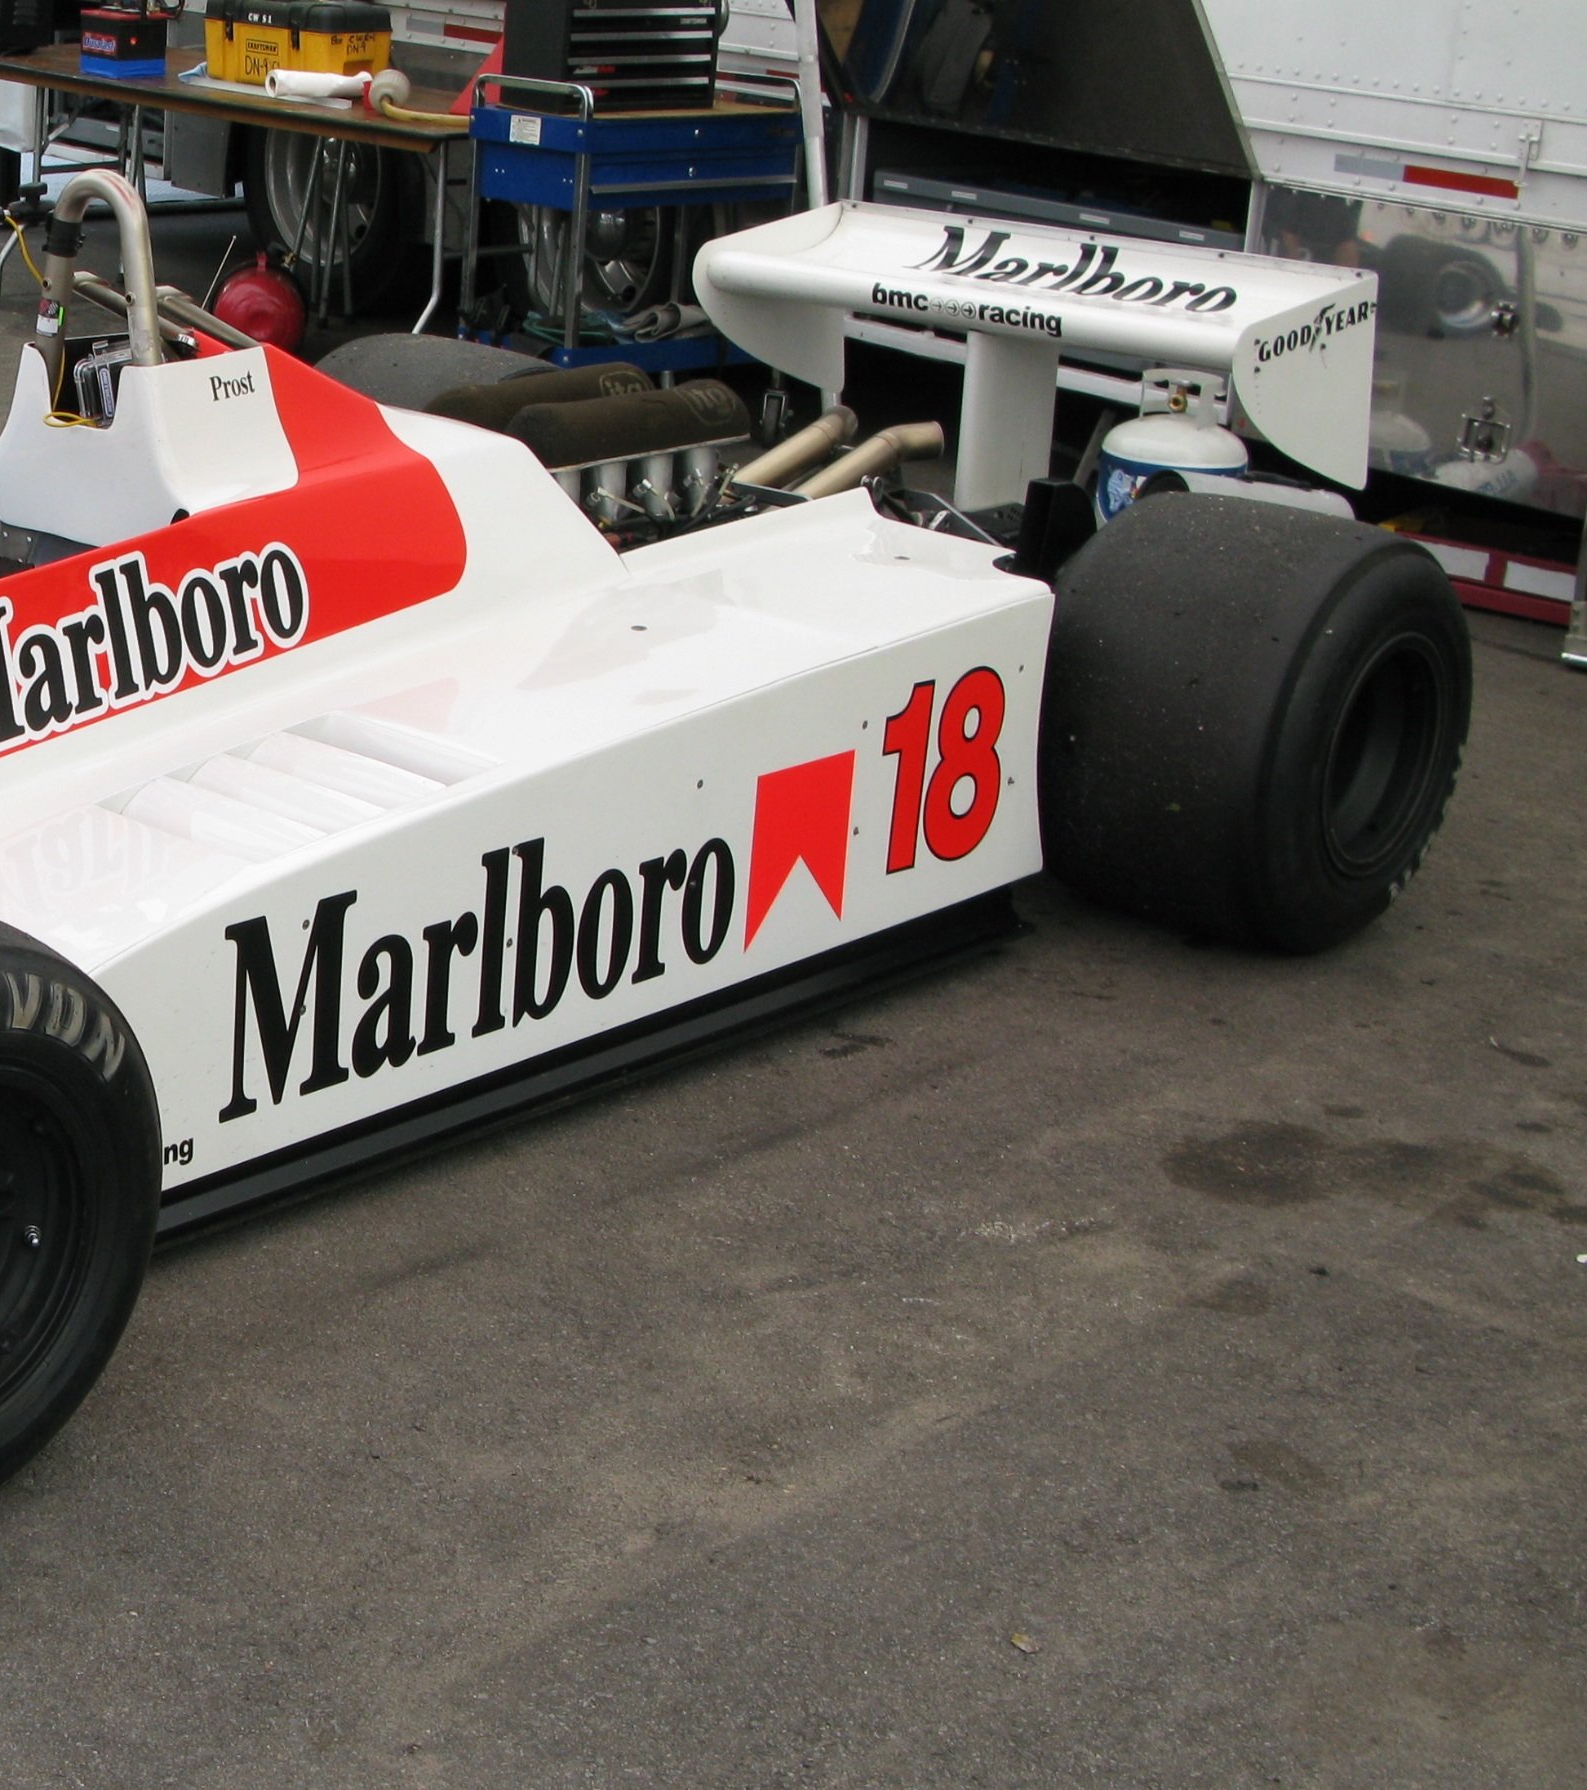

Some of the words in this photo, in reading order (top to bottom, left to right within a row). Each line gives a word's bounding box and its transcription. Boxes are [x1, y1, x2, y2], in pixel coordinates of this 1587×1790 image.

[871, 283, 929, 312] bmc
[978, 301, 1063, 338] racing
[903, 225, 1238, 313] Marlboro
[209, 369, 256, 402] Prost
[882, 665, 1007, 876] 18
[218, 837, 736, 1124] Marlboro
